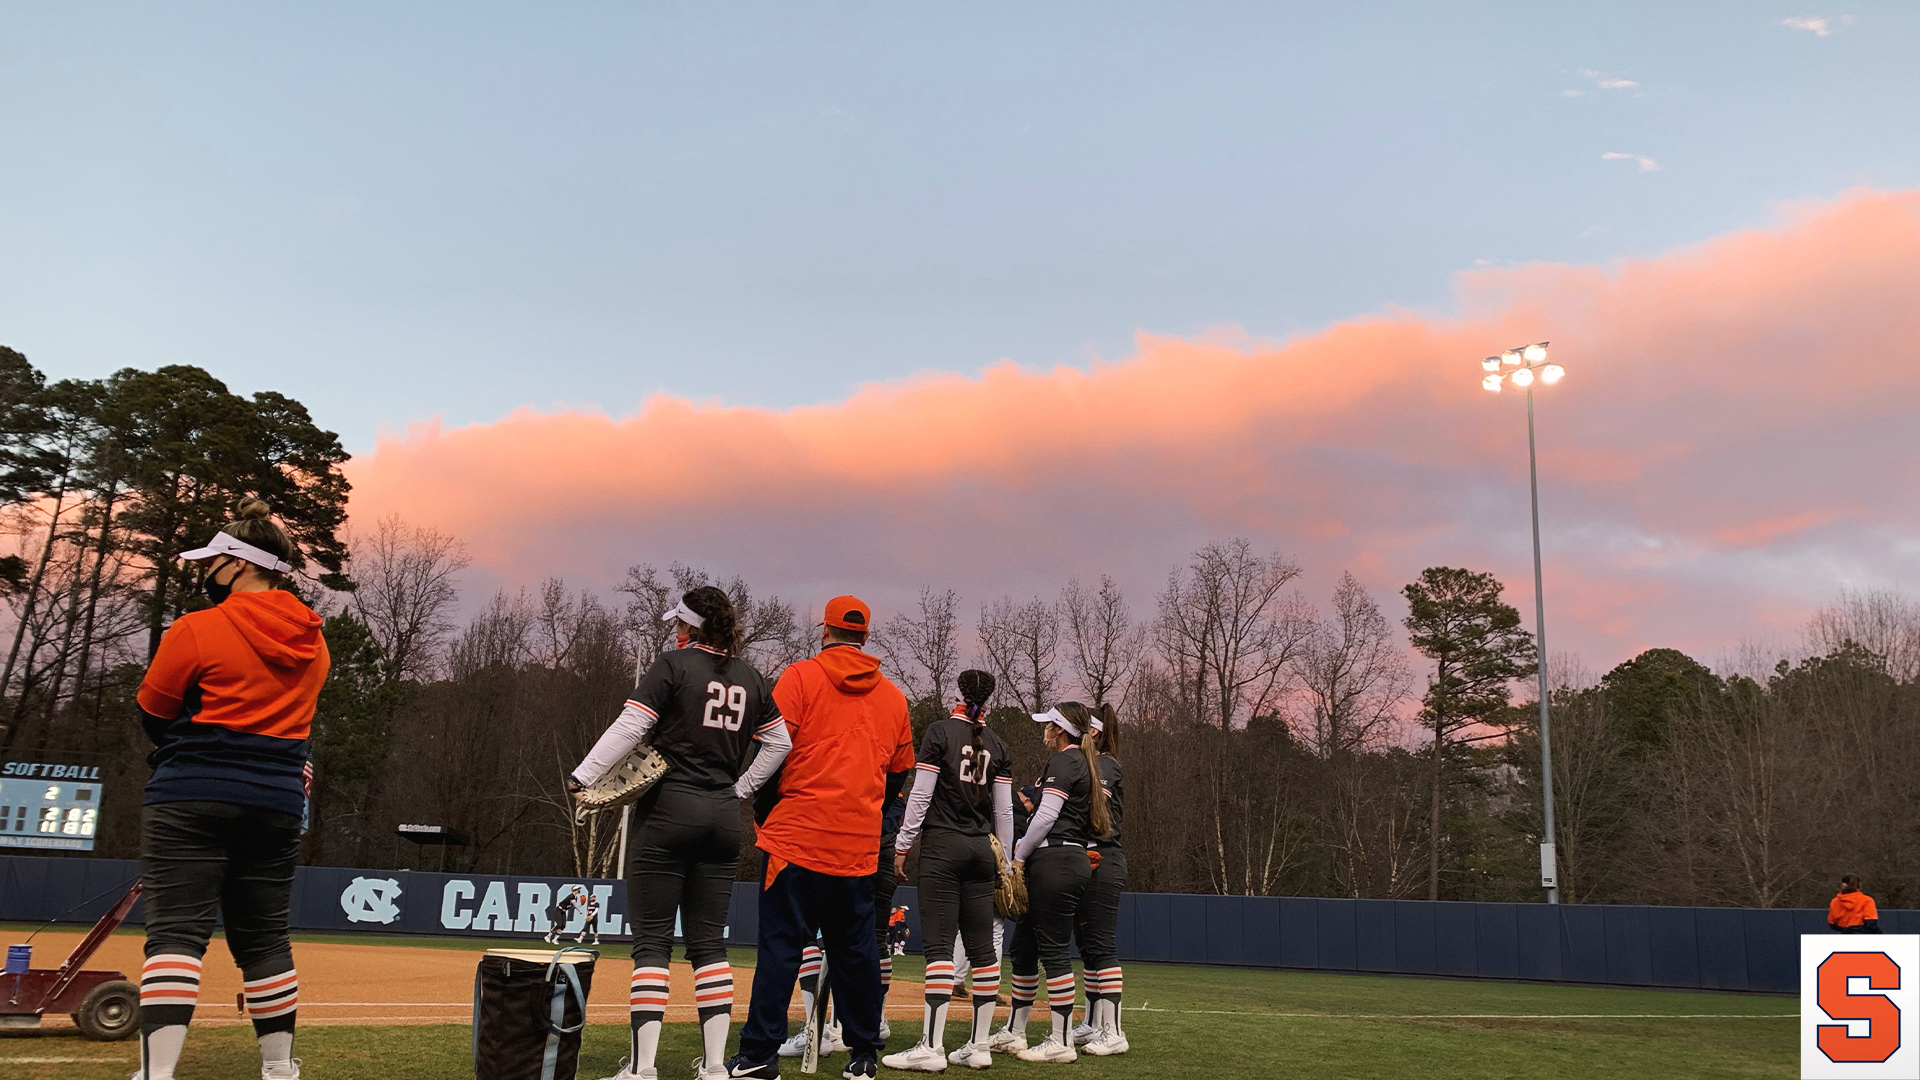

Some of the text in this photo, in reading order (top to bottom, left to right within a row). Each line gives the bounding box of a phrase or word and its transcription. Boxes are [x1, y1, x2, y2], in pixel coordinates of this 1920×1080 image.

[703, 681, 747, 731] 29
[1, 762, 100, 779] SOFTBALL
[960, 745, 991, 785] 20
[45, 786, 59, 800] 2
[45, 807, 60, 820] 2
[82, 809, 96, 822] 2
[440, 880, 729, 939] CAROL
